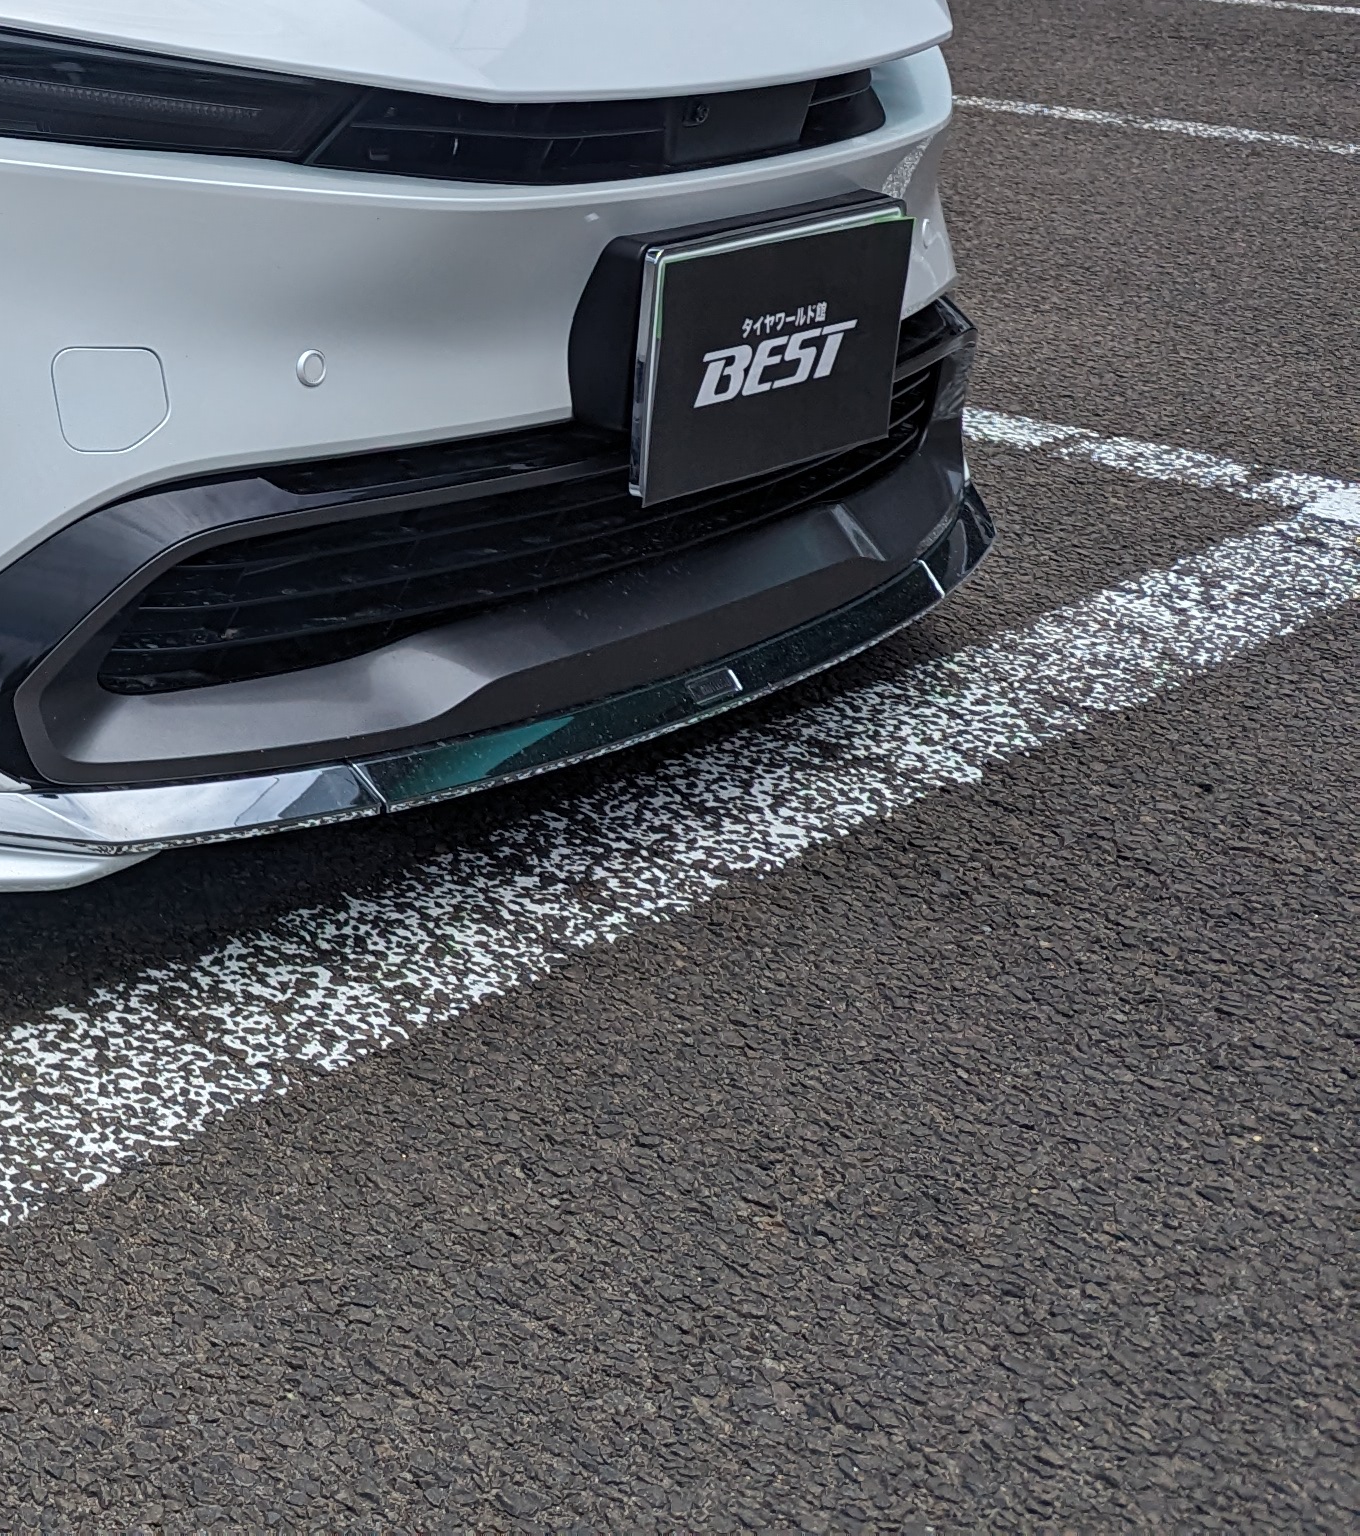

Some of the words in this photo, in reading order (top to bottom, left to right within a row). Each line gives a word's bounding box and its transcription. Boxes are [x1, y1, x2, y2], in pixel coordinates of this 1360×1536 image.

[741, 301, 828, 339] タイヤワールド館
[693, 318, 859, 409] BEST
